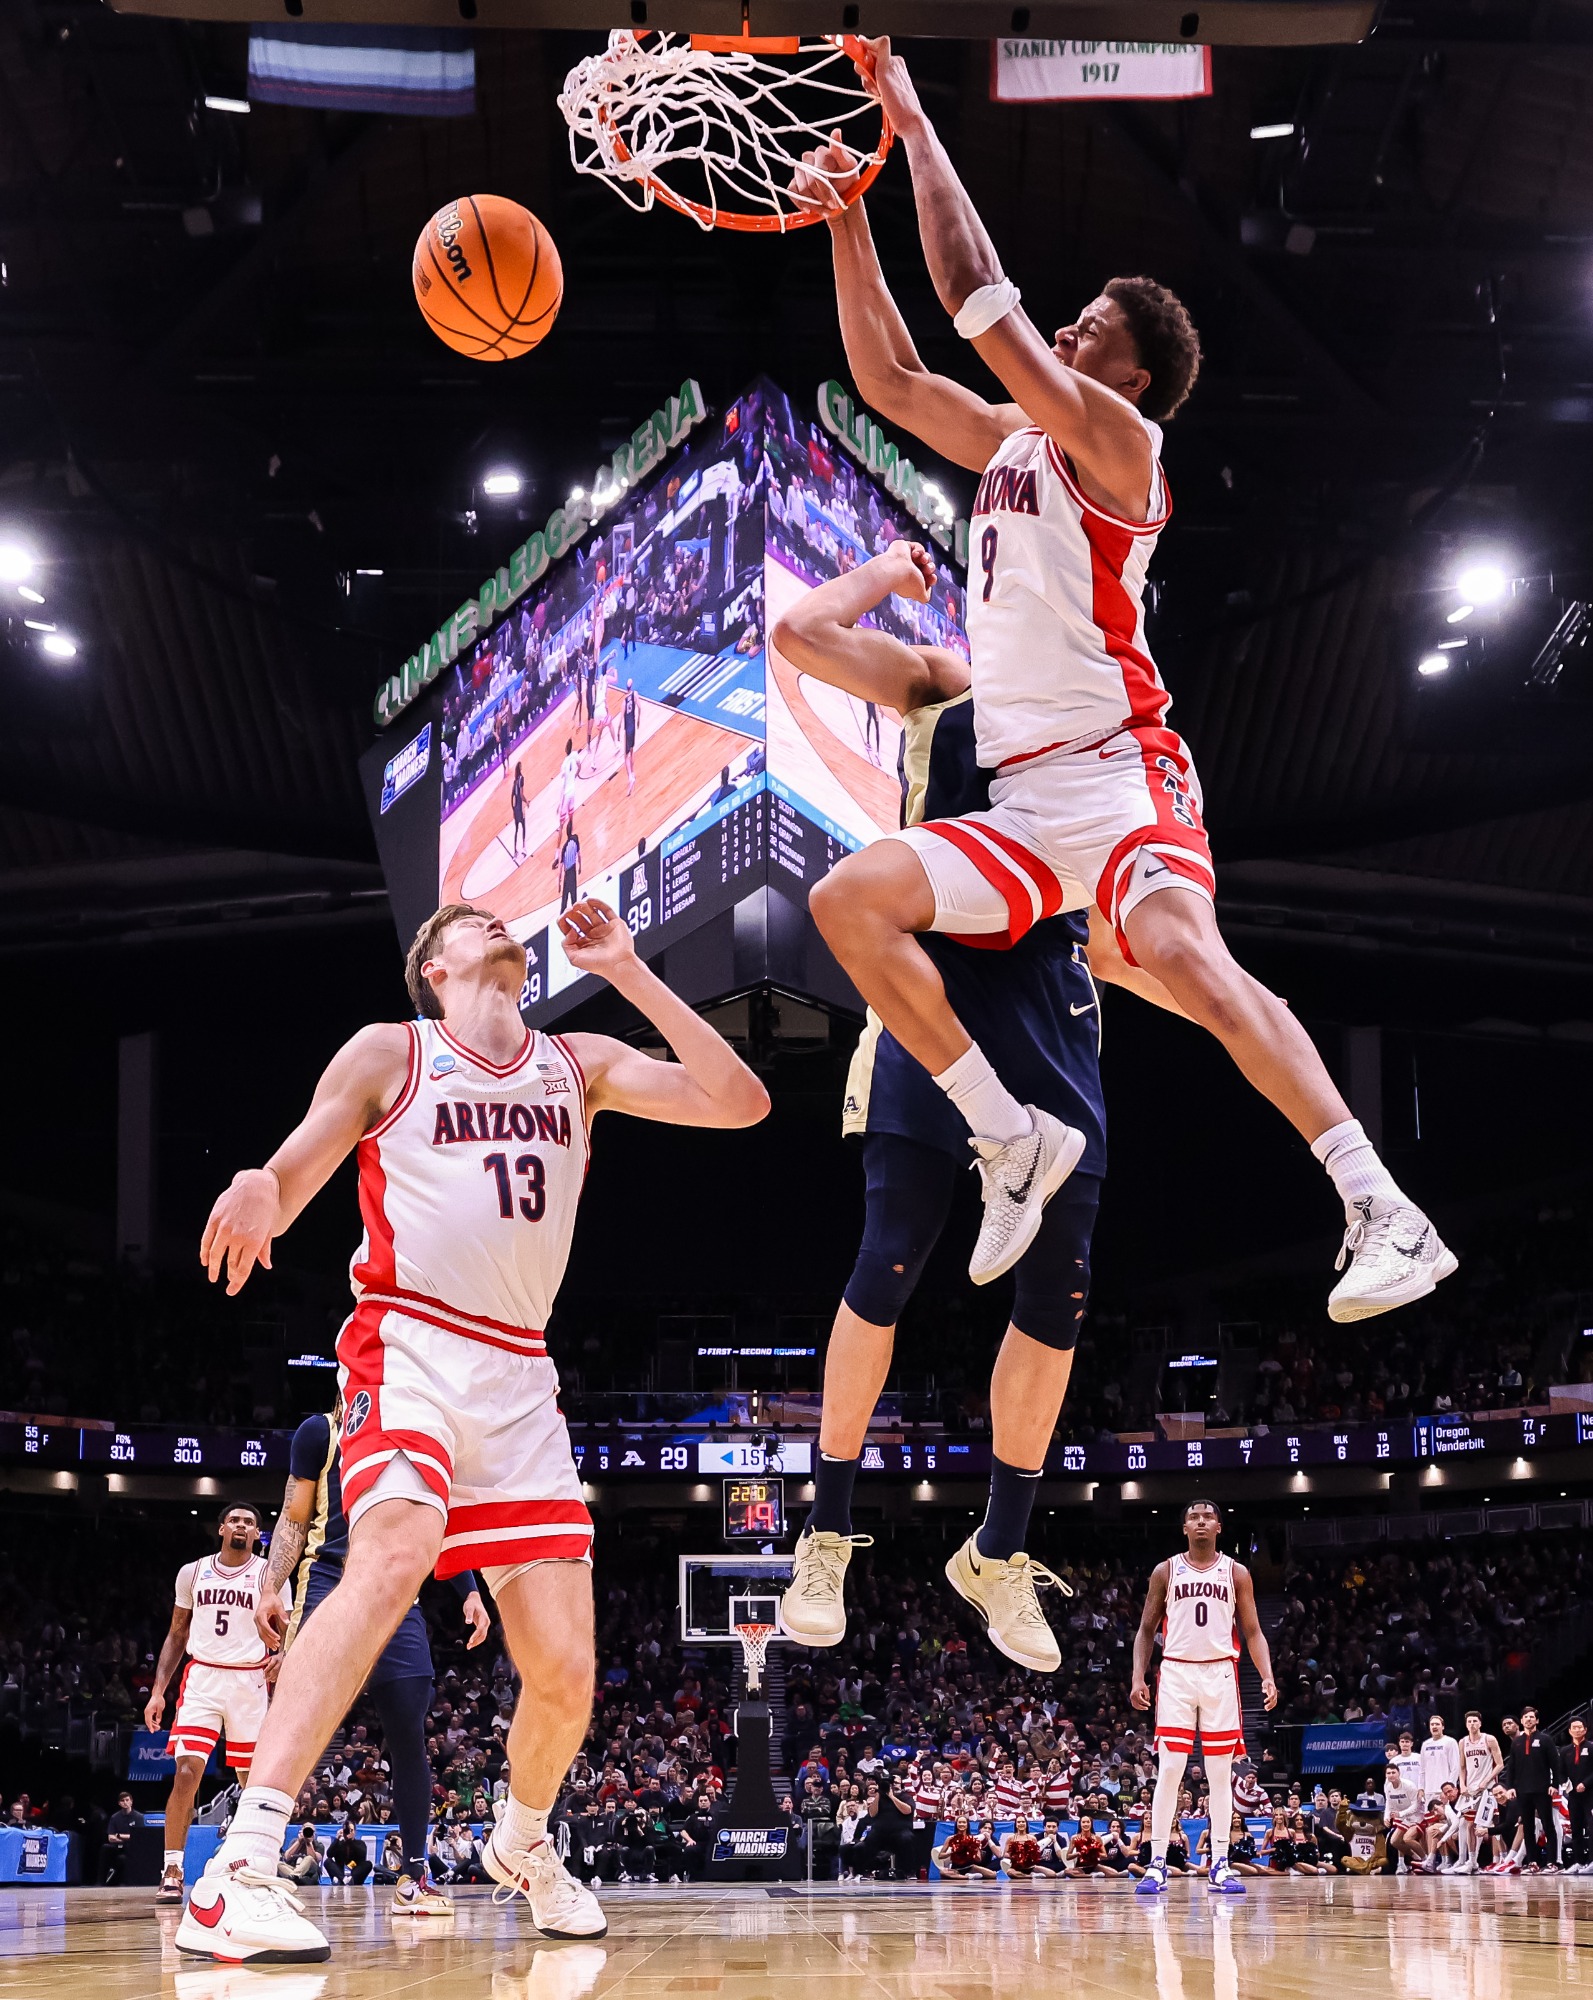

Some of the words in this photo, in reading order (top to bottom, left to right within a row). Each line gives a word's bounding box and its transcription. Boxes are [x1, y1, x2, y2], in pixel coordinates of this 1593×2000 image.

[1081, 63, 1120, 82] 1917
[981, 525, 998, 602] 9
[373, 598, 480, 726] CLIMATE
[627, 897, 652, 938] 39
[520, 973, 541, 1011] 29
[432, 1101, 572, 1150] ARIZONA
[483, 1152, 546, 1223] 13
[773, 1348, 807, 1356] ROUNDS
[1523, 1419, 1534, 1431] 77
[1540, 1424, 1547, 1436] F
[25, 1426, 38, 1438] 55
[1378, 1432, 1388, 1442] TO
[1436, 1427, 1469, 1438] Oregon
[43, 1434, 49, 1446] F
[115, 1434, 131, 1445] FG%
[177, 1437, 199, 1448] 3PT%
[246, 1440, 262, 1450] FT%
[1239, 1439, 1254, 1449] AST
[1287, 1437, 1301, 1446] STL
[1333, 1435, 1349, 1444] BLK
[1436, 1438, 1485, 1452] Vanderbilt
[1524, 1433, 1536, 1445] 73
[25, 1441, 38, 1453] 82
[110, 1445, 135, 1461] 31.4
[948, 1445, 969, 1453] BONUS
[1065, 1446, 1084, 1455] 3PT%
[1129, 1445, 1144, 1454] FT%
[1187, 1442, 1201, 1451] REB
[1337, 1446, 1346, 1460] 6
[1376, 1443, 1390, 1458] 12
[173, 1449, 202, 1464] 30.0
[240, 1452, 267, 1466] 66.7
[620, 1450, 646, 1466] A
[660, 1447, 688, 1470] 29
[1187, 1453, 1203, 1466] 28
[1242, 1450, 1250, 1464] 7
[1290, 1448, 1299, 1462] 2
[575, 1456, 584, 1470] 7
[600, 1456, 609, 1470] 3
[903, 1456, 911, 1469] 3
[927, 1456, 936, 1469] 5
[1063, 1456, 1086, 1470] 41.7
[1127, 1455, 1146, 1470] 0.0
[746, 1503, 772, 1531] 19
[197, 1588, 254, 1611] ARIZONA
[1174, 1582, 1229, 1604] ARIZONA
[1195, 1601, 1208, 1628] 0
[214, 1610, 230, 1637] 5
[1306, 1739, 1384, 1750] #MARCHMADNESS
[138, 1747, 175, 1760] NCA
[1473, 1757, 1480, 1769] 3
[730, 1832, 768, 1843] MARCH
[734, 1843, 786, 1854] MADNESS
[1360, 1846, 1371, 1855] 25
[229, 1858, 250, 1872] BOOK
